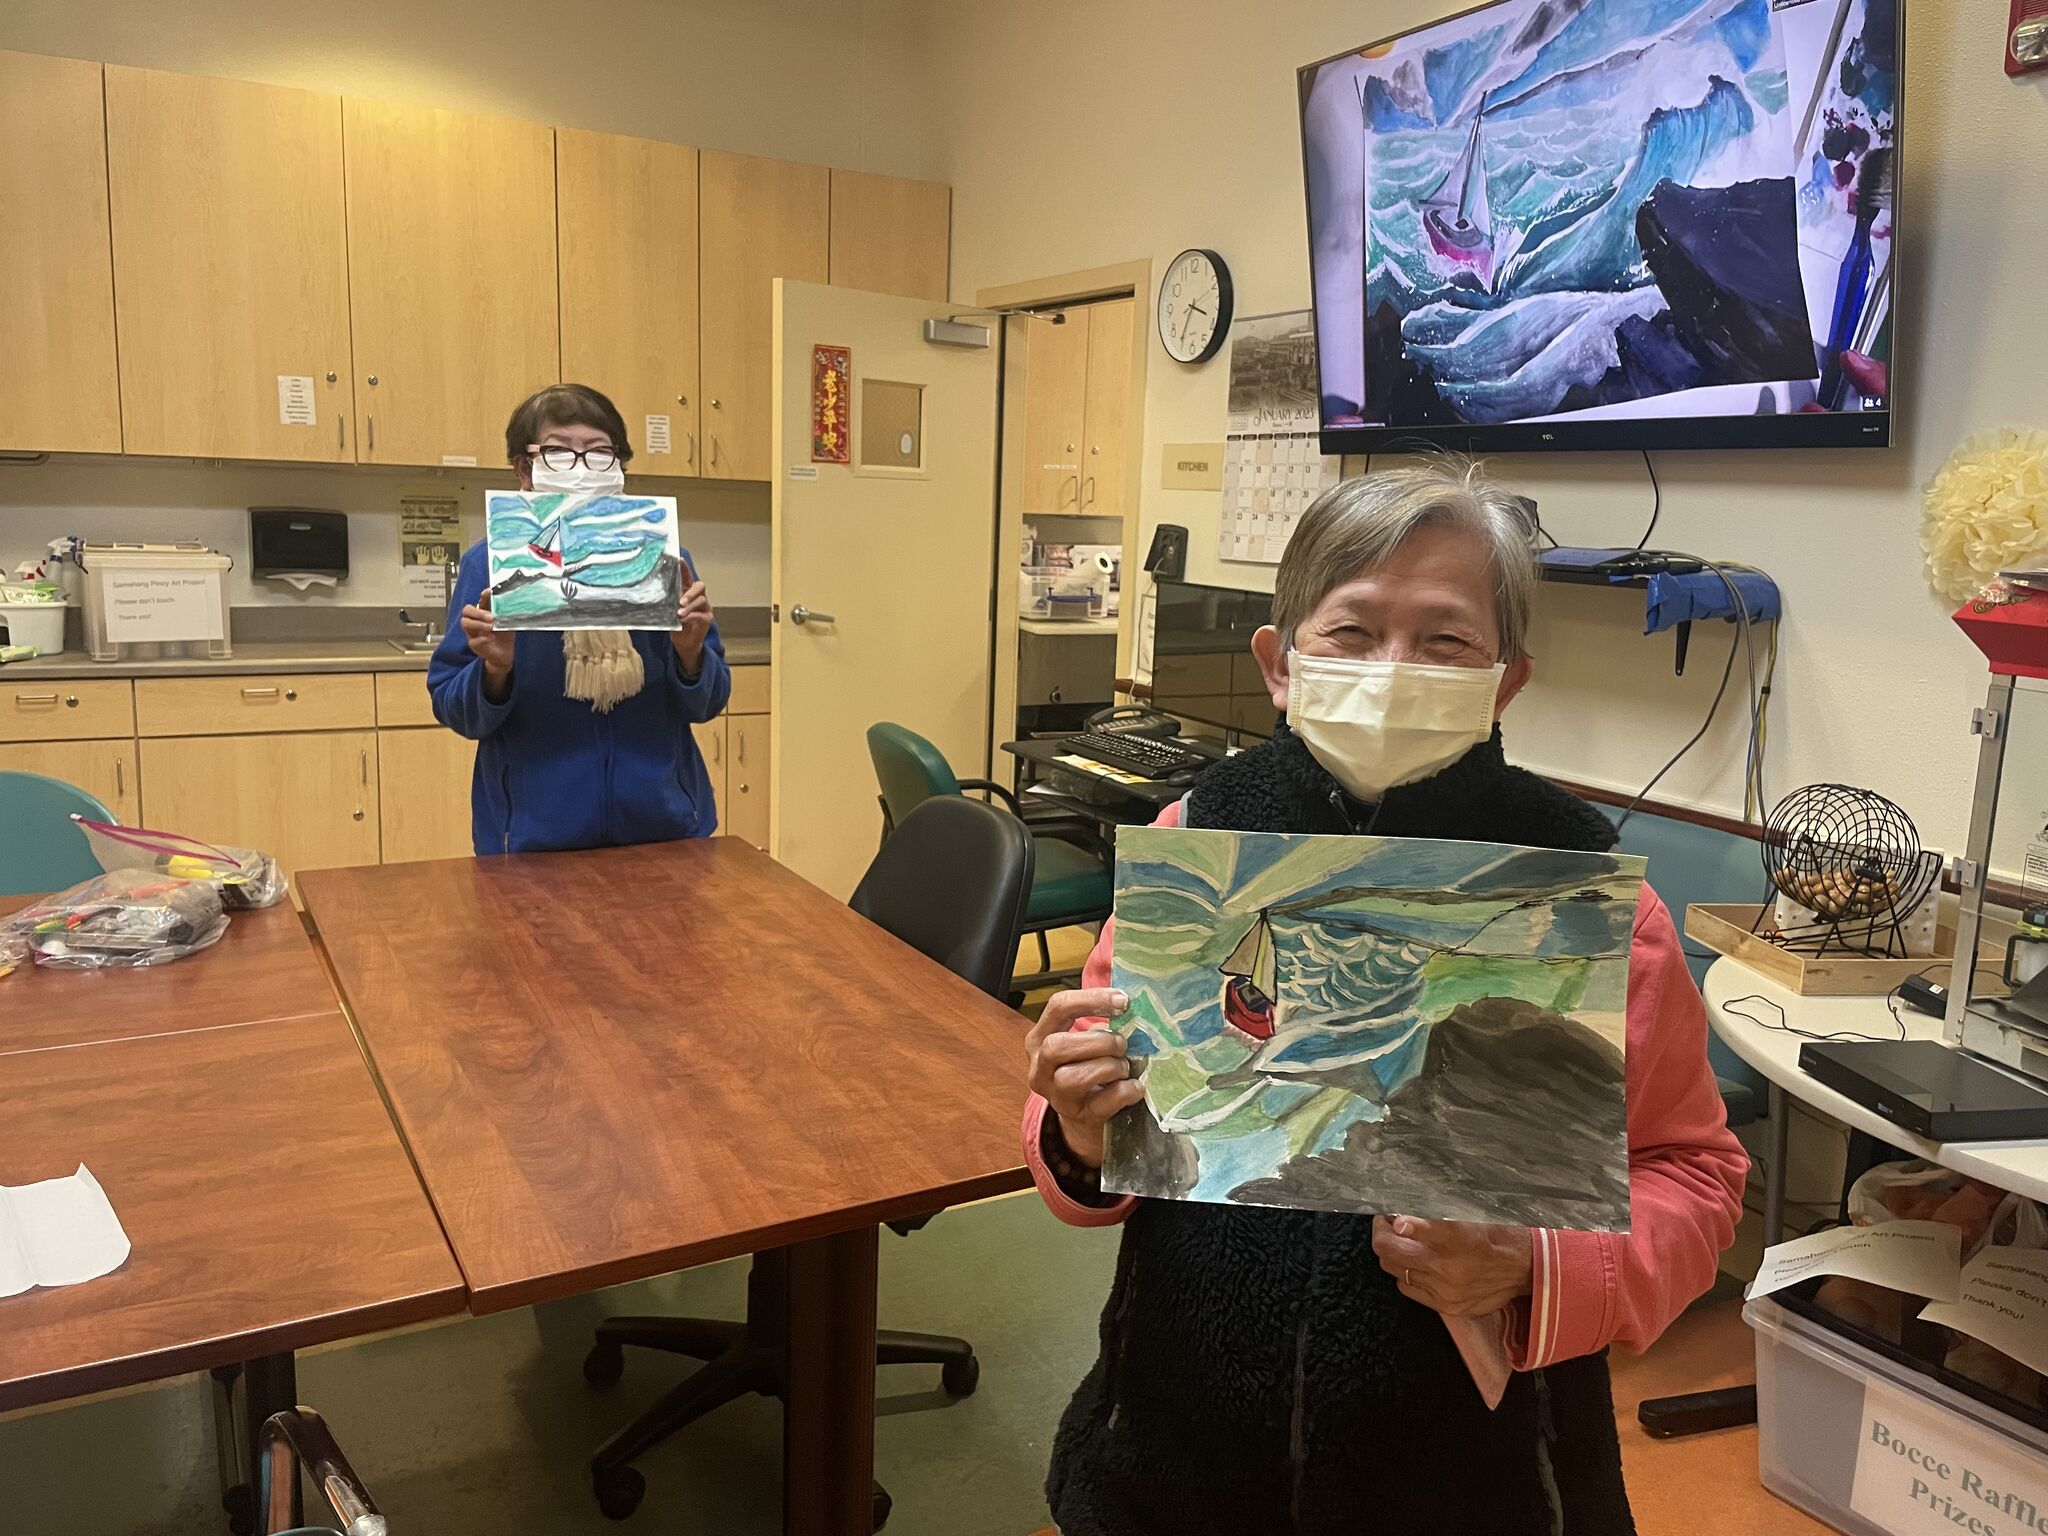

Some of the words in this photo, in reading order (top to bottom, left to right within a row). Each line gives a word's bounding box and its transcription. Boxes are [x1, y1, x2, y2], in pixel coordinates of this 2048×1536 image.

[1181, 264, 1188, 281] 11
[1190, 258, 1199, 273] 12
[1172, 283, 1181, 297] 10
[1167, 303, 1173, 315] 9
[1171, 323, 1176, 338] 8
[1201, 333, 1207, 349] 5
[1189, 343, 1196, 355] 6
[1875, 397, 1881, 407] 4
[1176, 461, 1209, 472] KITCHEN
[1970, 1277, 2013, 1292] Please
[1962, 1294, 1995, 1308] Thank
[1996, 1306, 2024, 1320] you!
[1871, 1419, 1950, 1480] Bocce
[1961, 1467, 2048, 1536] Raffle
[1909, 1477, 1996, 1536] Prizes
